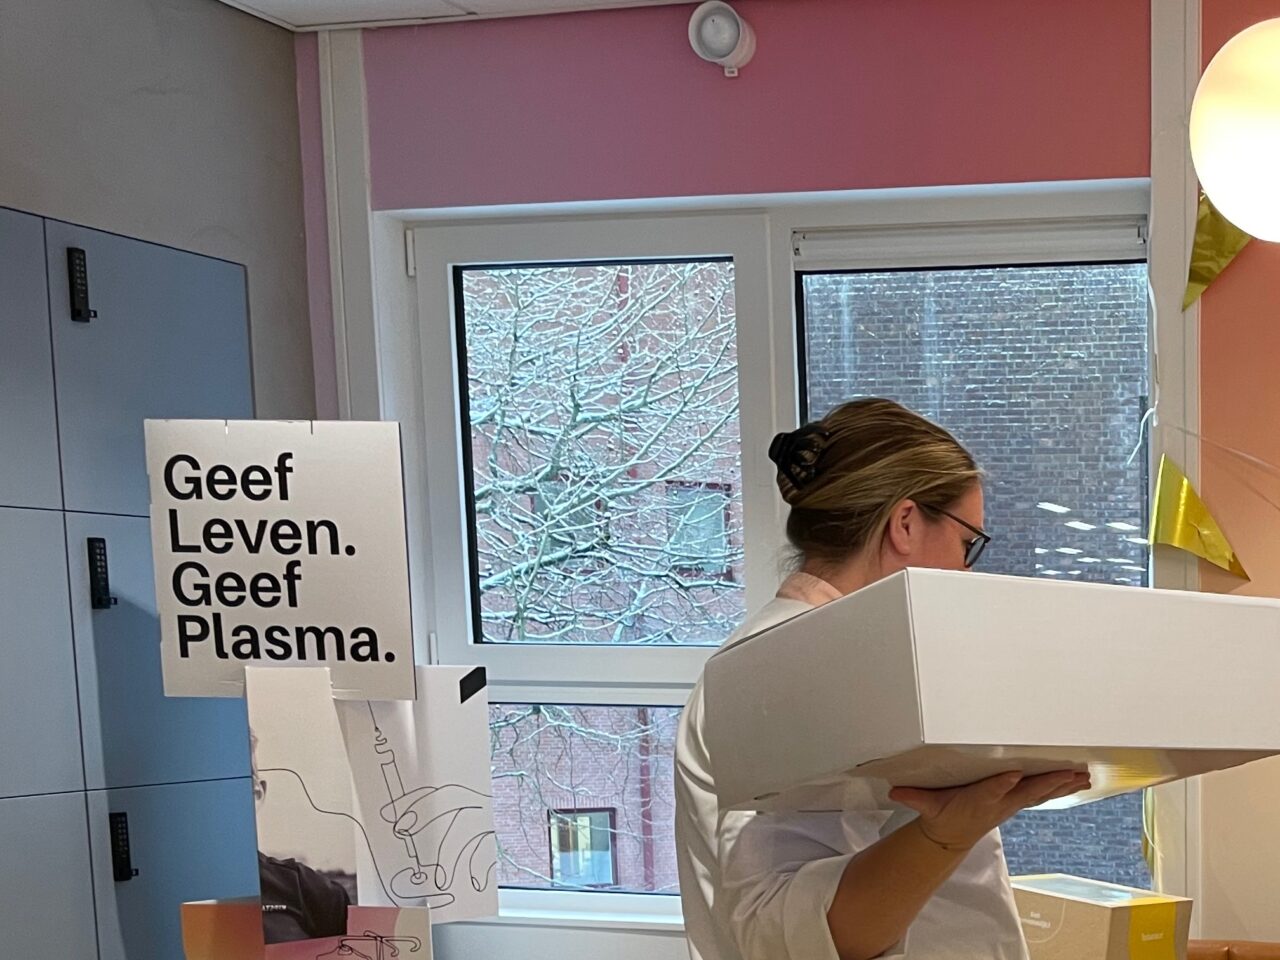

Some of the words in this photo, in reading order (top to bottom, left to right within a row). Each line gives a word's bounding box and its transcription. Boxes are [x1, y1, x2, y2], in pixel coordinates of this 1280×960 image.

[164, 452, 293, 501] Geef
[168, 508, 356, 556] Leven.
[172, 559, 302, 608] Geef
[177, 612, 396, 662] Plasma.
